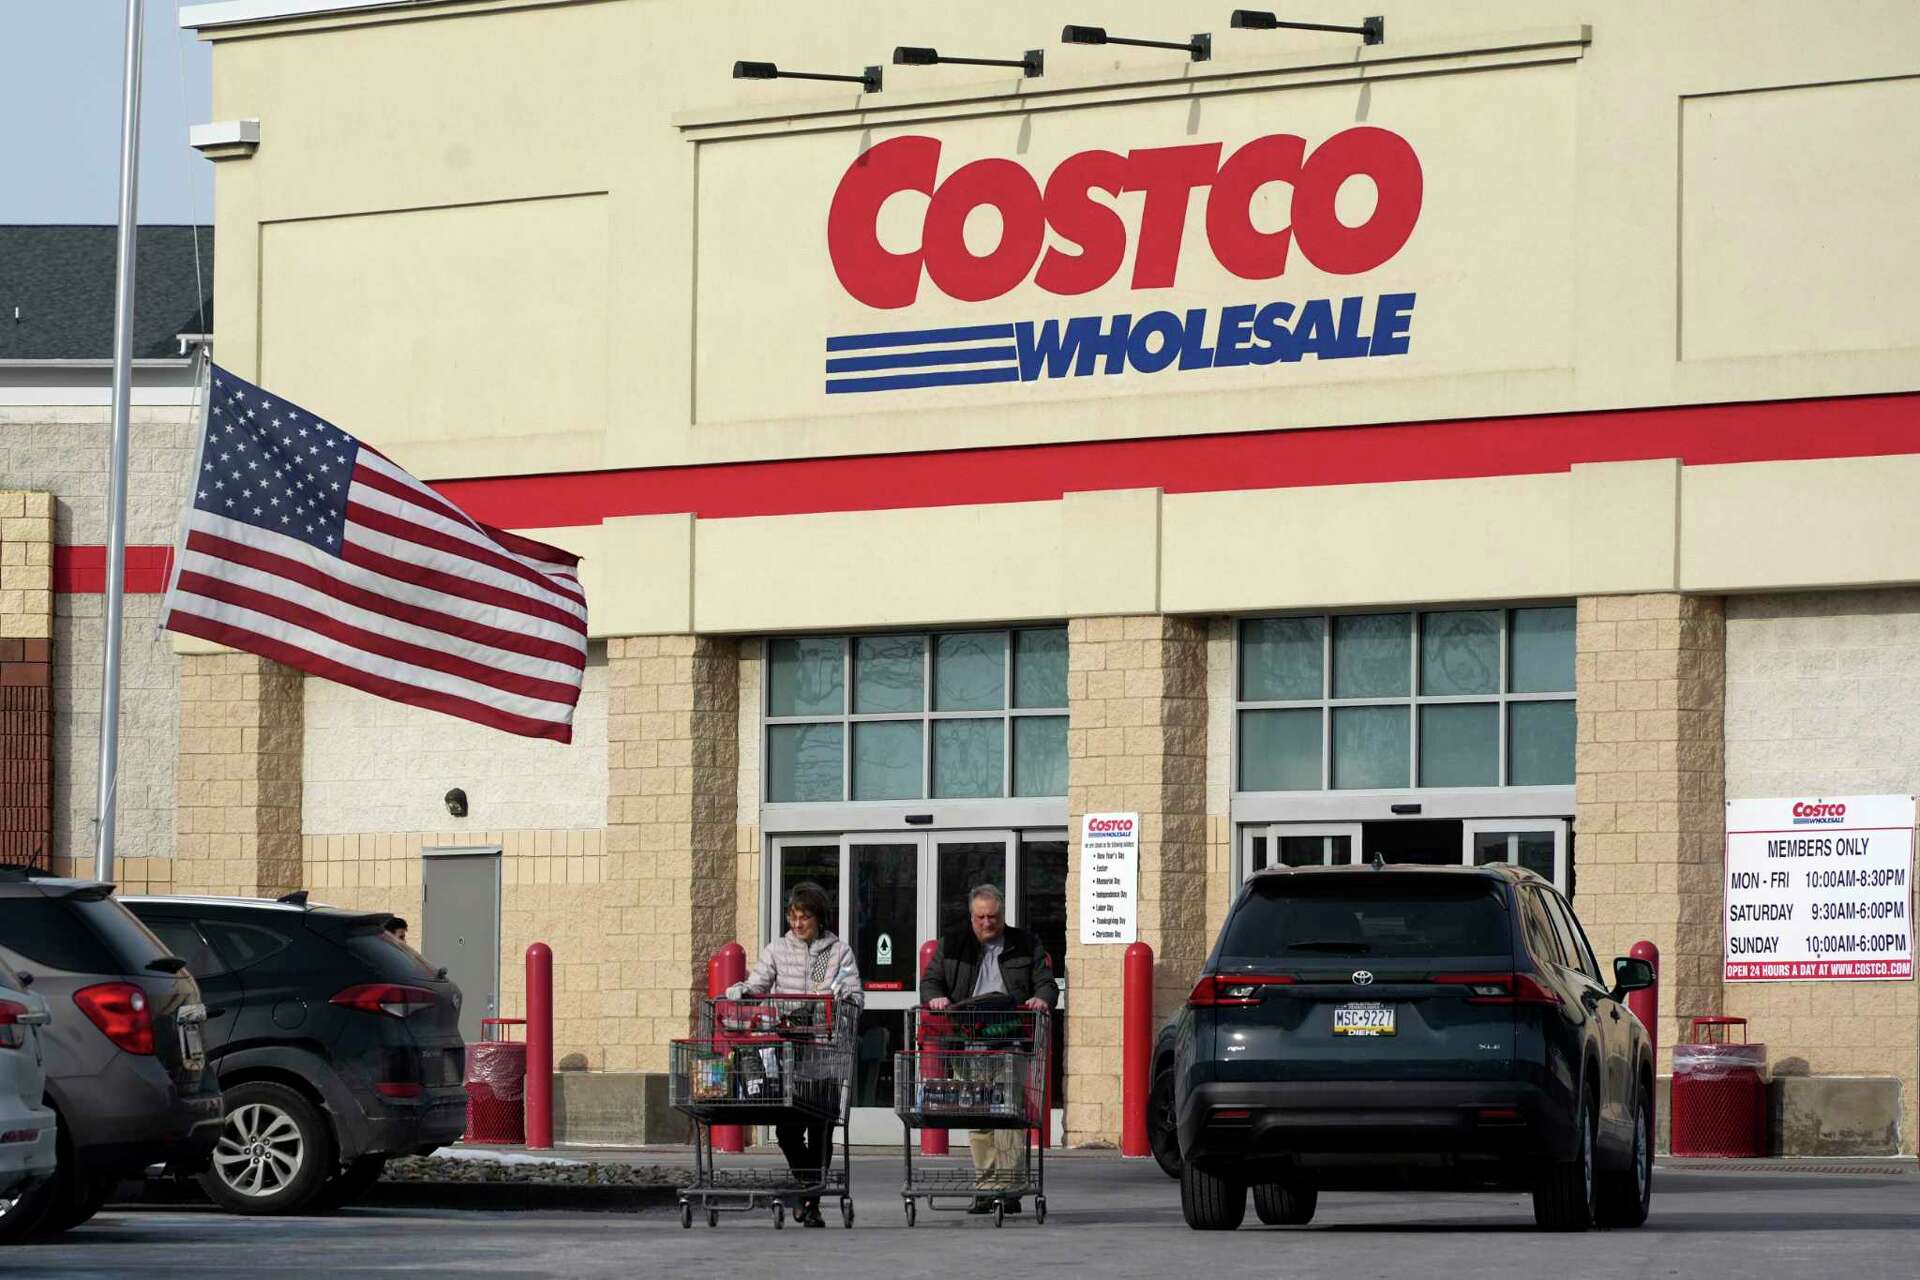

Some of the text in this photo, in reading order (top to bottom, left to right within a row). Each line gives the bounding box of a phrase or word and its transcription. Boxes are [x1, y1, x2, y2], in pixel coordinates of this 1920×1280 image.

[827, 126, 1424, 310] COSTCO
[1015, 292, 1417, 382] WHOLESALE
[1792, 802, 1846, 817] COSTCO
[1088, 818, 1133, 831] COSTCO
[1768, 838, 1869, 858] MEMBERS ONLY
[1731, 872, 1760, 889] MON
[1770, 872, 1790, 889] FRI
[1805, 869, 1905, 888] 10:00AM-8:30PM
[1730, 901, 1904, 921] SATURDAY 9:30AM-6:00PM
[1730, 934, 1906, 954] SUNDAY 10:00AM-6:00PM
[1727, 962, 1911, 977] OPEN 24 HOURS A DAY AT WWW.COSTCO.COM
